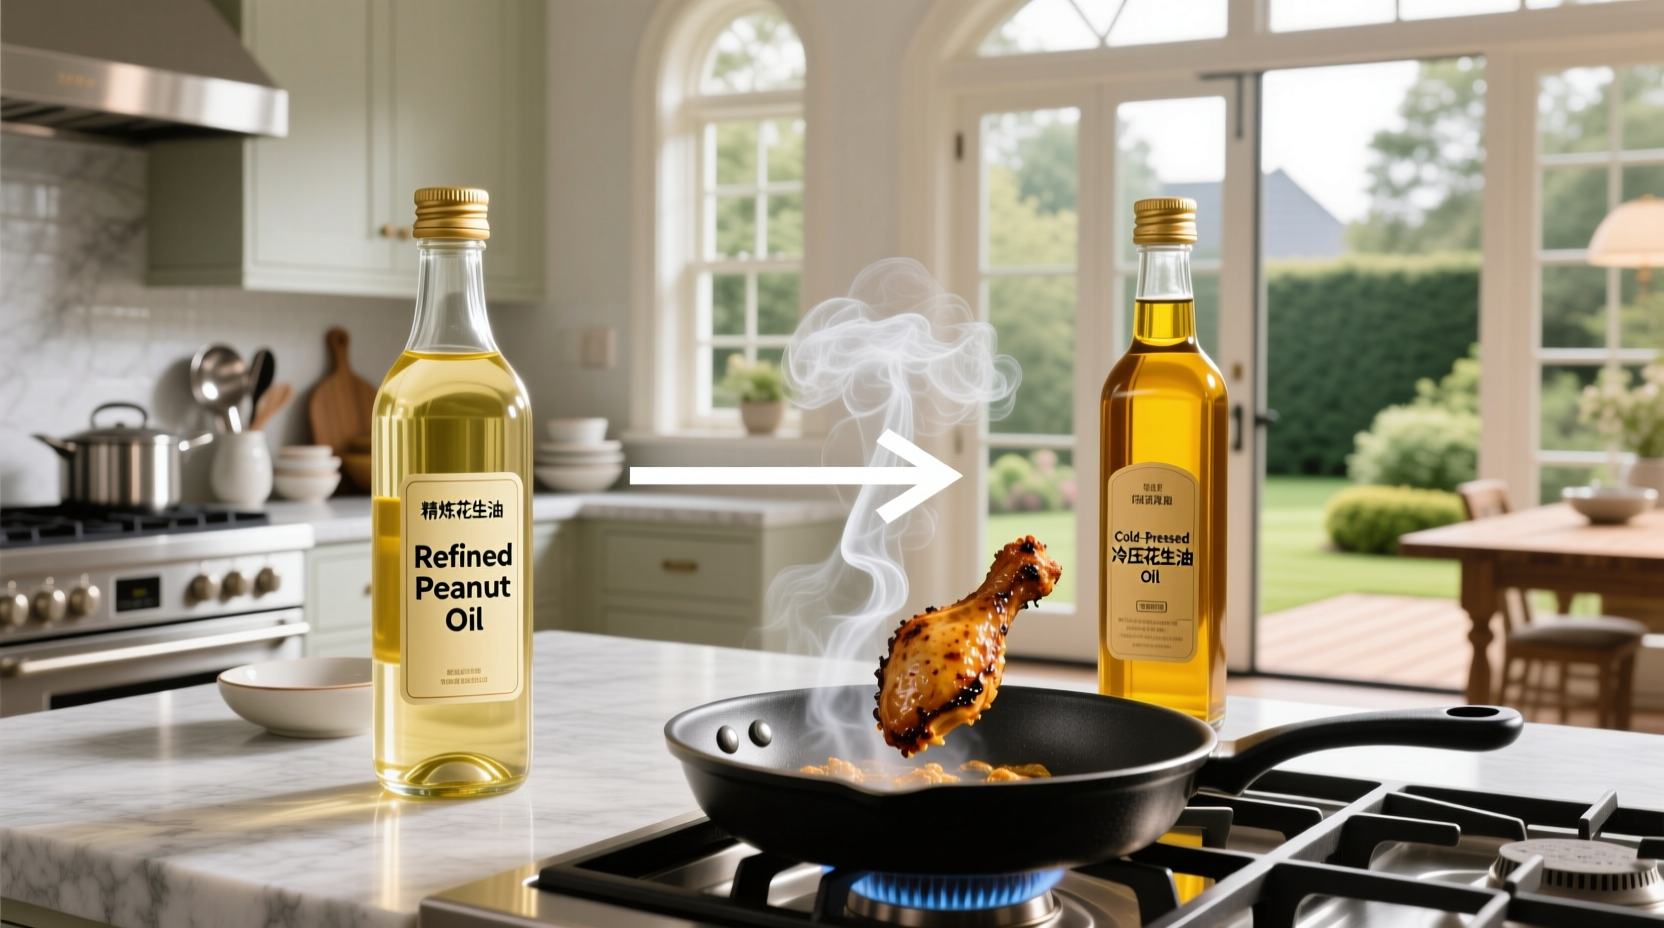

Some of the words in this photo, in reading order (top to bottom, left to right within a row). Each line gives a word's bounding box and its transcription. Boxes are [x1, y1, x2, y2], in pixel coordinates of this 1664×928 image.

[421, 499, 504, 521] 精炼花生油
[415, 542, 512, 568] Refined
[1112, 546, 1194, 566] 冷压花生油
[416, 576, 511, 600] Peanut
[1140, 570, 1160, 584] Oil
[446, 607, 484, 632] Oil
